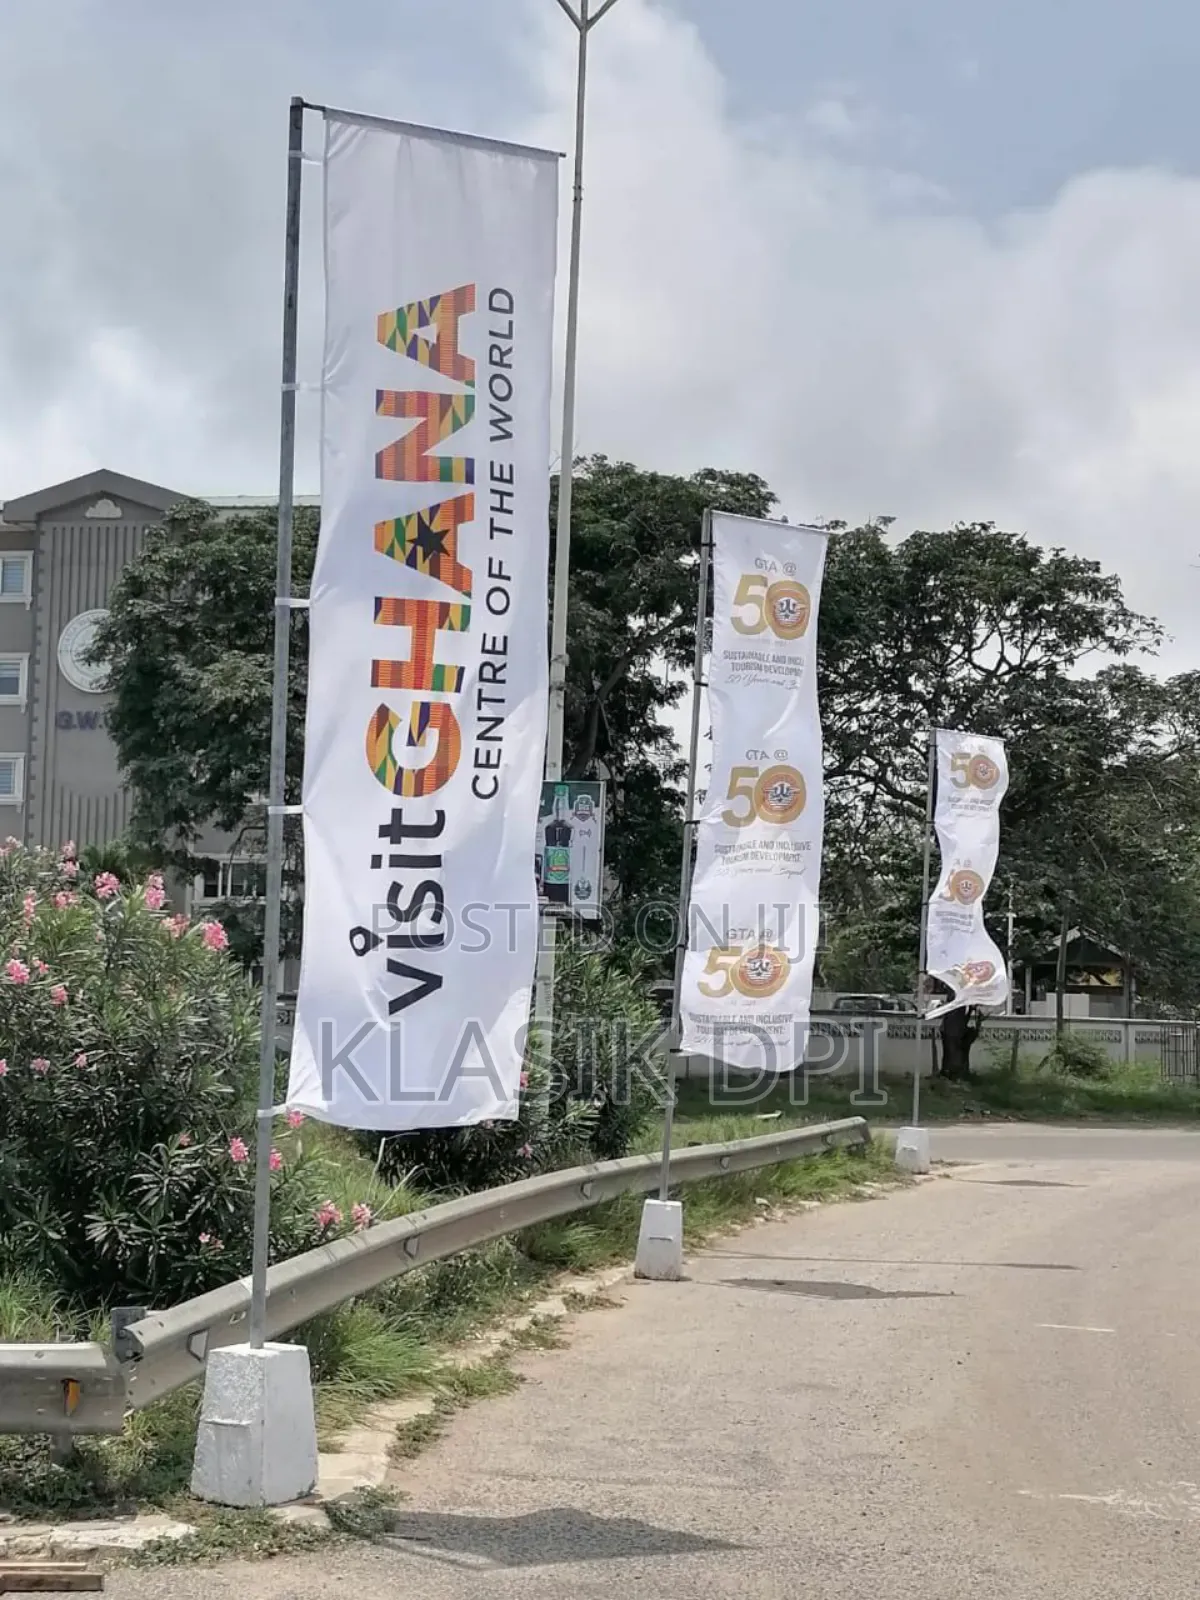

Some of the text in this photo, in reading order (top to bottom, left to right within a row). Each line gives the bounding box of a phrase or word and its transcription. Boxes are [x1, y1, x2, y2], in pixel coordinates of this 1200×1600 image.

[471, 287, 515, 800] CENTRE OF THE WORLD
[755, 558, 778, 573] GTA
[730, 574, 811, 640] 50
[721, 764, 806, 828] 50
[726, 928, 755, 940] GTA
[697, 945, 791, 998] 50
